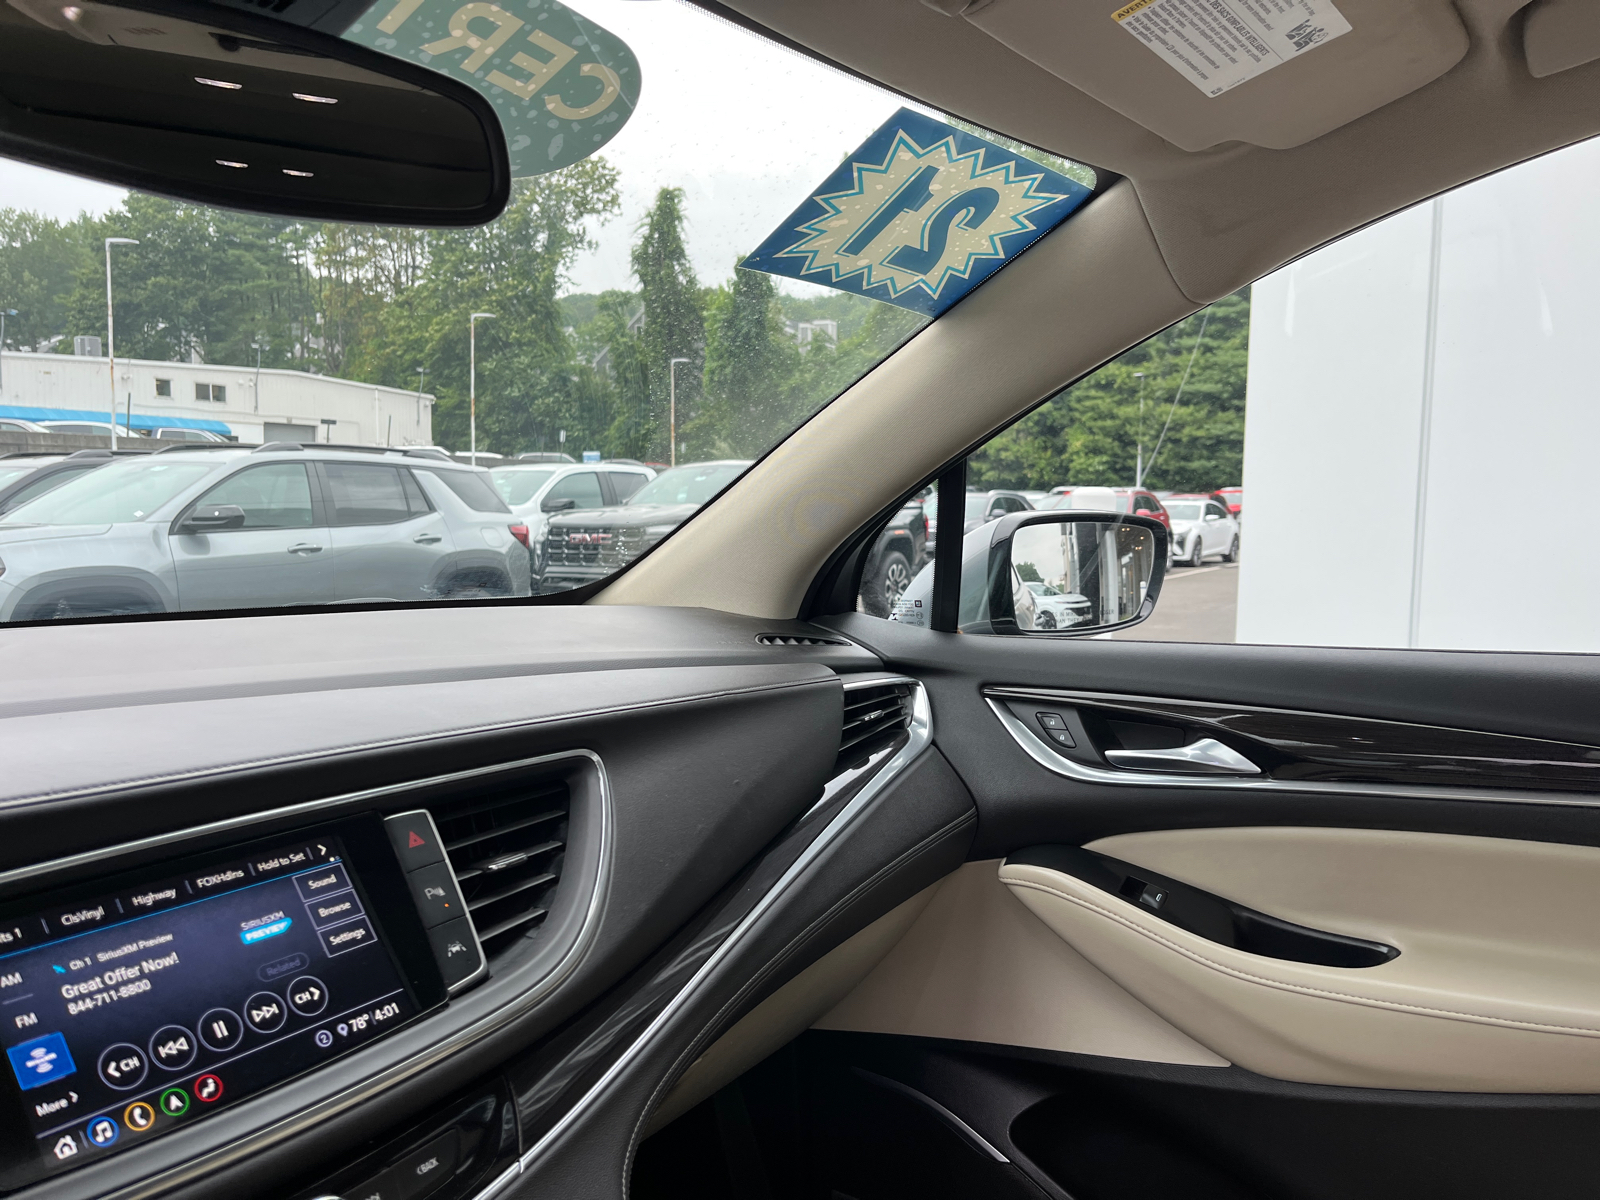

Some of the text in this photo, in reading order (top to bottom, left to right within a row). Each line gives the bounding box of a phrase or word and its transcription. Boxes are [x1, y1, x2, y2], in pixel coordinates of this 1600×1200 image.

[1117, 0, 1152, 19] AVERT
[569, 533, 613, 545] GMC
[257, 859, 280, 872] Hold
[289, 852, 306, 863] Set
[308, 874, 337, 890] Sound
[132, 888, 177, 907] Highway
[318, 902, 352, 918] Browse
[240, 911, 285, 931] SIRIUSXM
[245, 921, 287, 942] PREVIEW
[329, 927, 366, 946] Settings
[69, 960, 85, 971] Ch
[138, 934, 173, 951] Preview
[61, 952, 180, 999] Great Offer Now!
[266, 958, 301, 976] Related
[0, 972, 23, 988] AM
[67, 979, 152, 1015] 844-711-8800
[294, 990, 311, 1004] CH
[15, 1012, 38, 1029] FM
[349, 1013, 369, 1032] 78°
[374, 1002, 400, 1021] 4:01
[119, 1056, 141, 1072] CH
[35, 1098, 69, 1117] More
